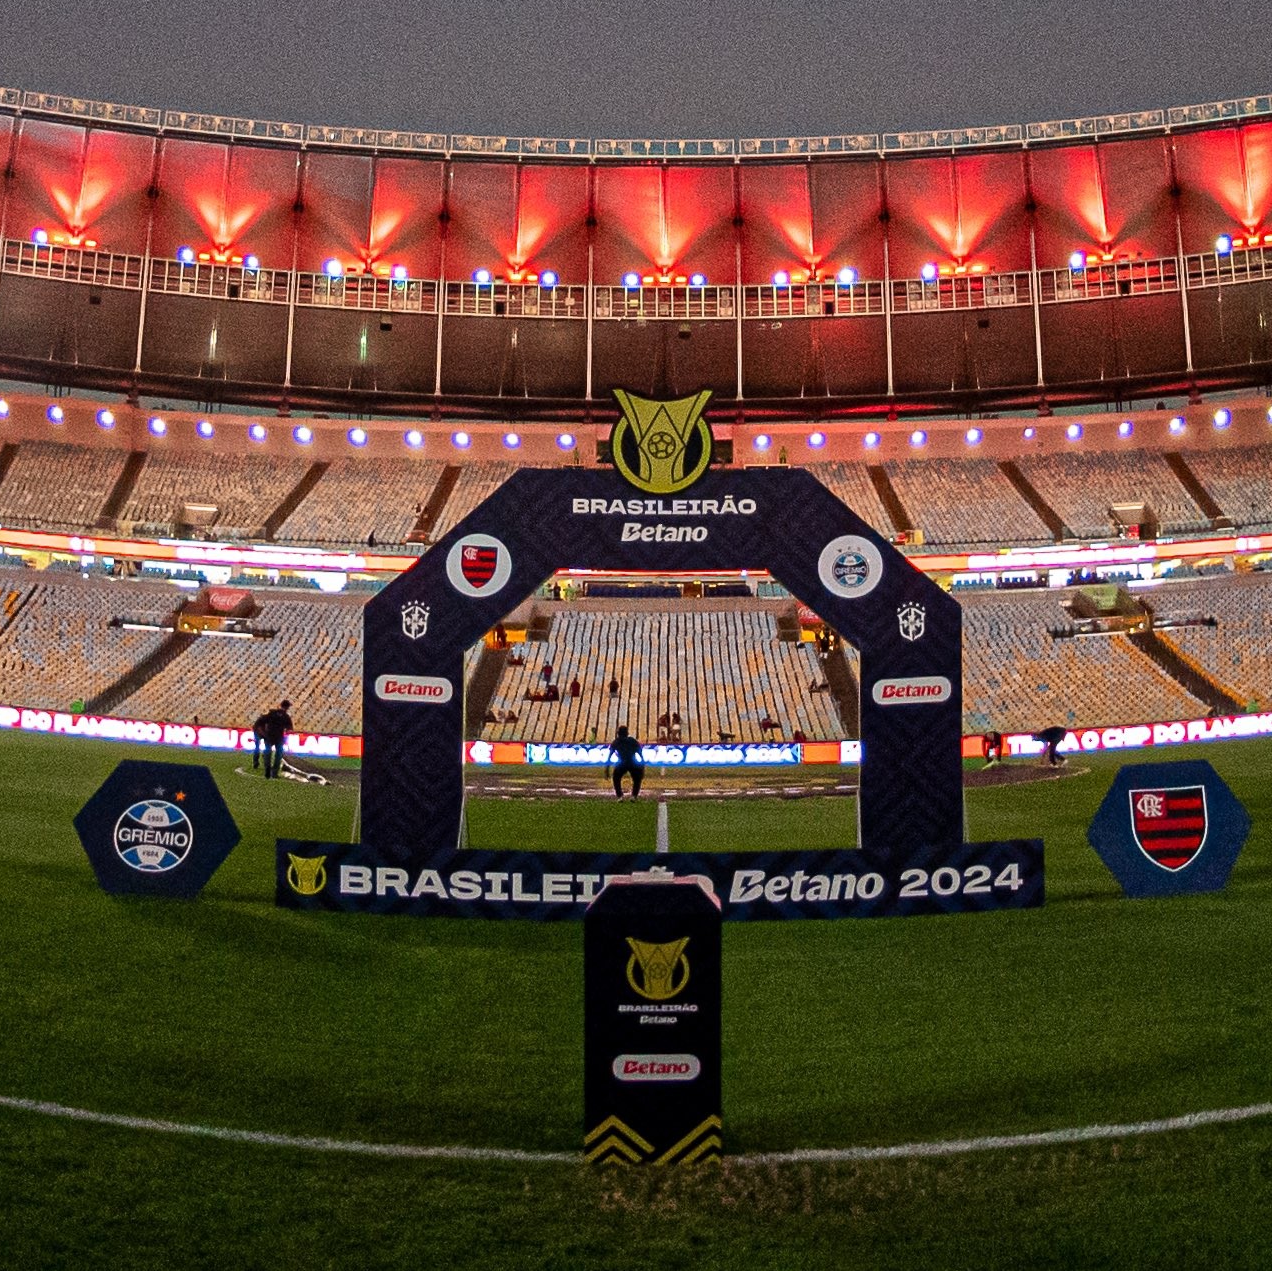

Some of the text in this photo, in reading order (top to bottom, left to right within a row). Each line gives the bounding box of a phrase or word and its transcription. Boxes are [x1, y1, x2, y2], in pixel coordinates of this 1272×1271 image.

[572, 495, 757, 515] BRASILEIRÃO
[621, 522, 708, 543] Betano
[385, 680, 443, 696] Betano
[882, 685, 942, 698] Betano
[240, 731, 339, 756] CLAR
[1007, 732, 1079, 754] TEA
[1081, 731, 1099, 750] O
[1154, 723, 1185, 743] DO
[549, 746, 683, 763] BRASRÃO
[118, 825, 188, 846] GRÊMIO
[340, 863, 1023, 903] BRASILEI Betano 2024
[618, 1003, 698, 1012] BRASILEIRÃO
[640, 1015, 677, 1024] Betano
[624, 1060, 690, 1074] Betano
